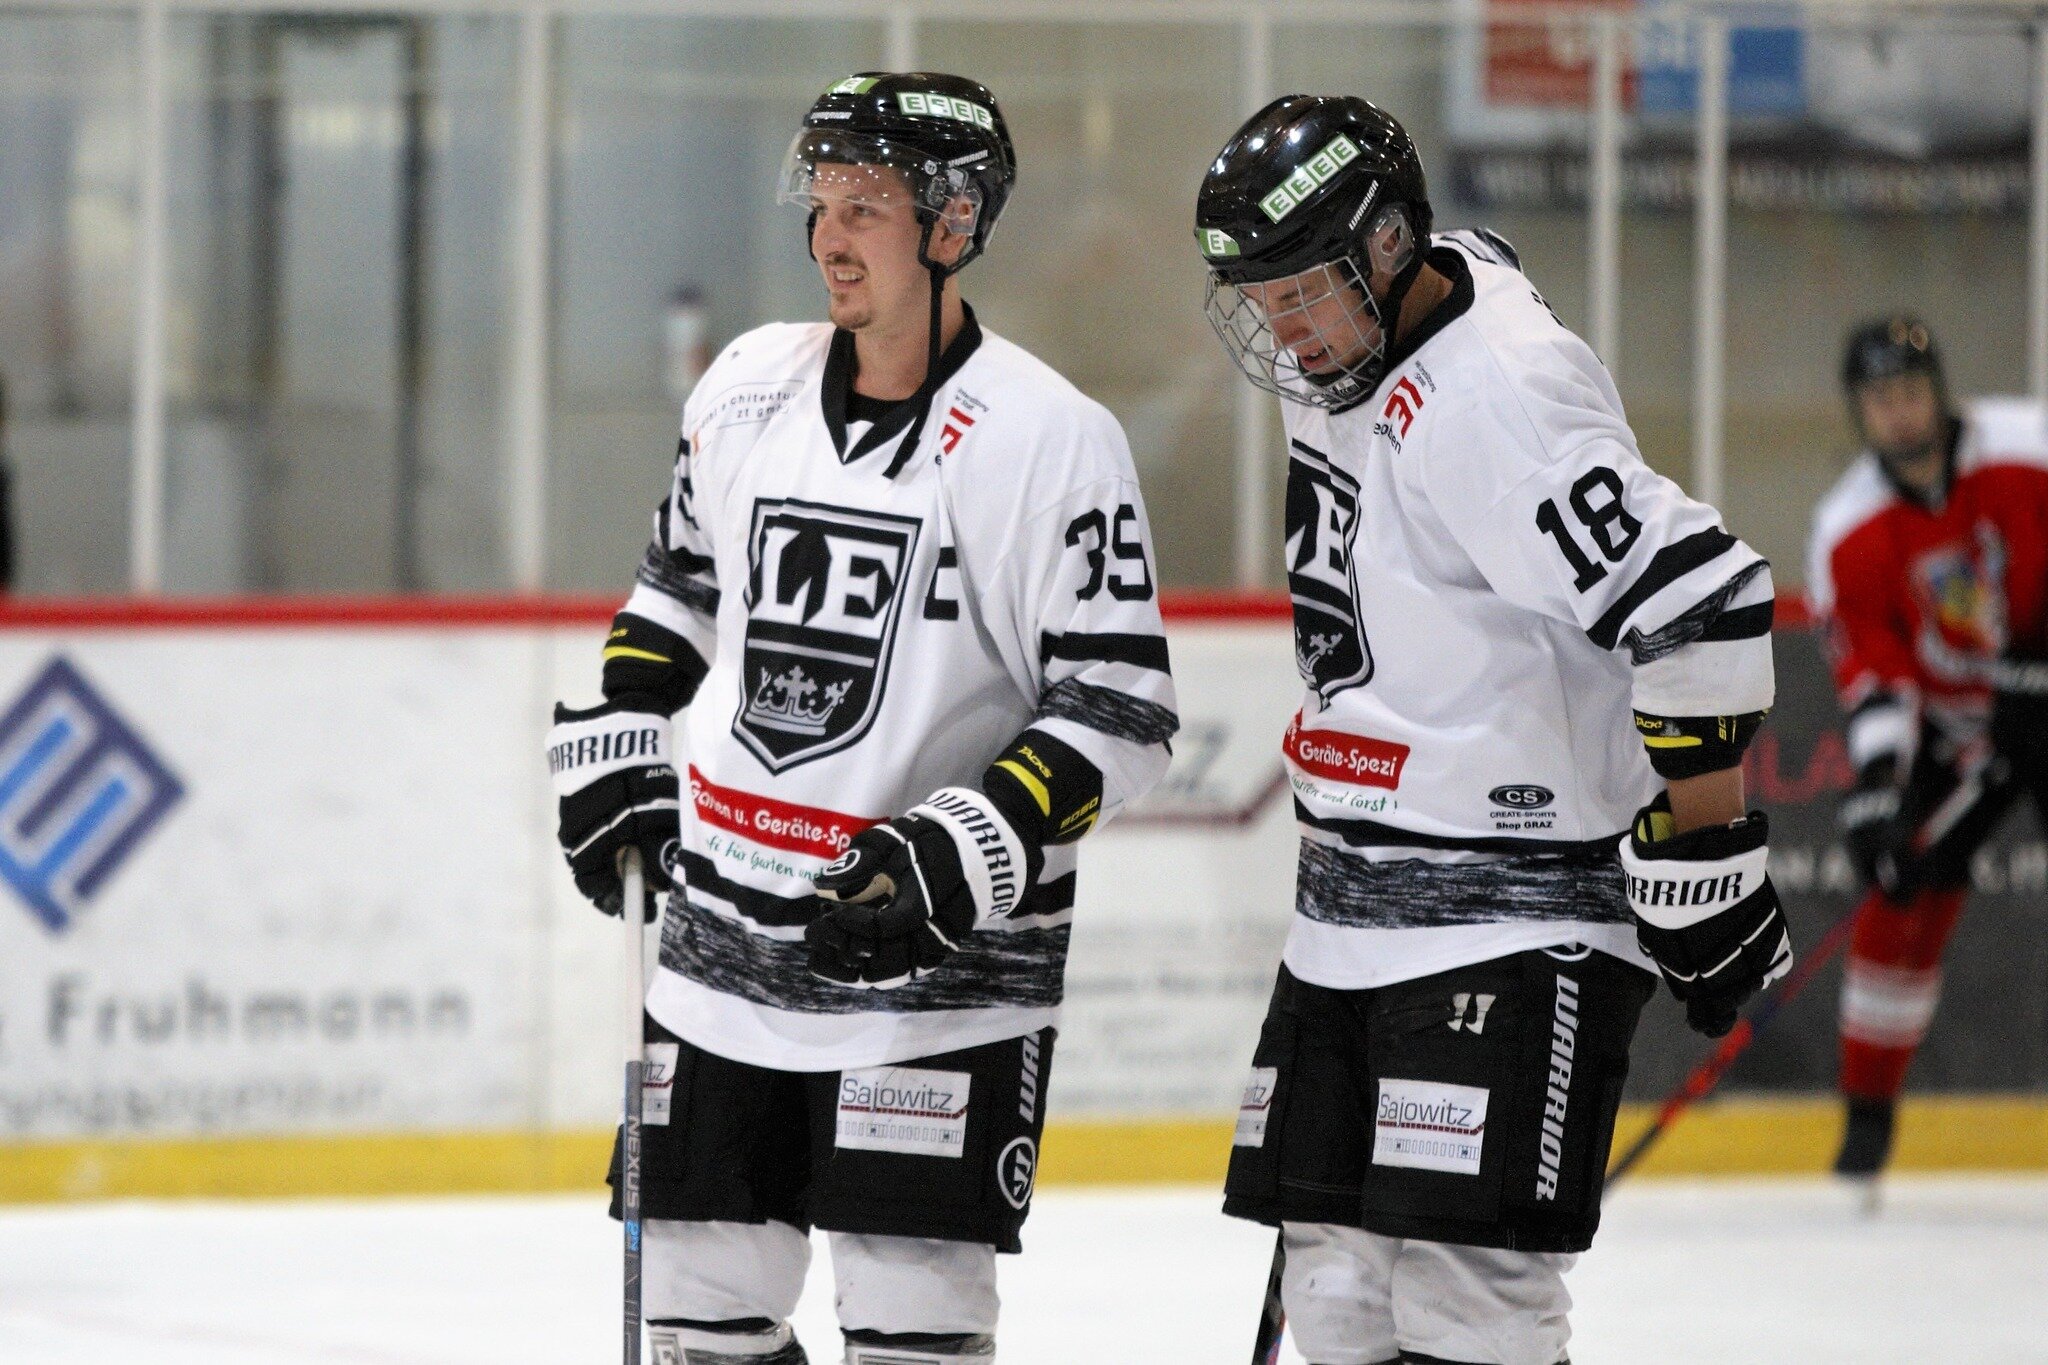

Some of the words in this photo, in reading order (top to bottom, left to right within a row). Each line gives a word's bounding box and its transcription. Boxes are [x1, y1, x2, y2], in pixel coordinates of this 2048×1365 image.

[1348, 179, 1379, 231] WARRIOR
[1286, 481, 1354, 597] E
[1535, 466, 1643, 594] 18
[750, 526, 901, 640] LE
[548, 728, 659, 774] ARRIOR
[1017, 745, 1053, 778] TACKS
[1300, 740, 1397, 777] Geräte-Spezi
[1506, 790, 1538, 804] CS
[754, 808, 851, 852] Geräte-Sp
[1496, 821, 1521, 831] Shop
[1524, 820, 1553, 829] GRAZ
[841, 1078, 954, 1112] Sajowitz
[1539, 973, 1580, 1201] WARRIOR
[1378, 1093, 1473, 1128] Sajowitz
[626, 1113, 642, 1209] NEXUS
